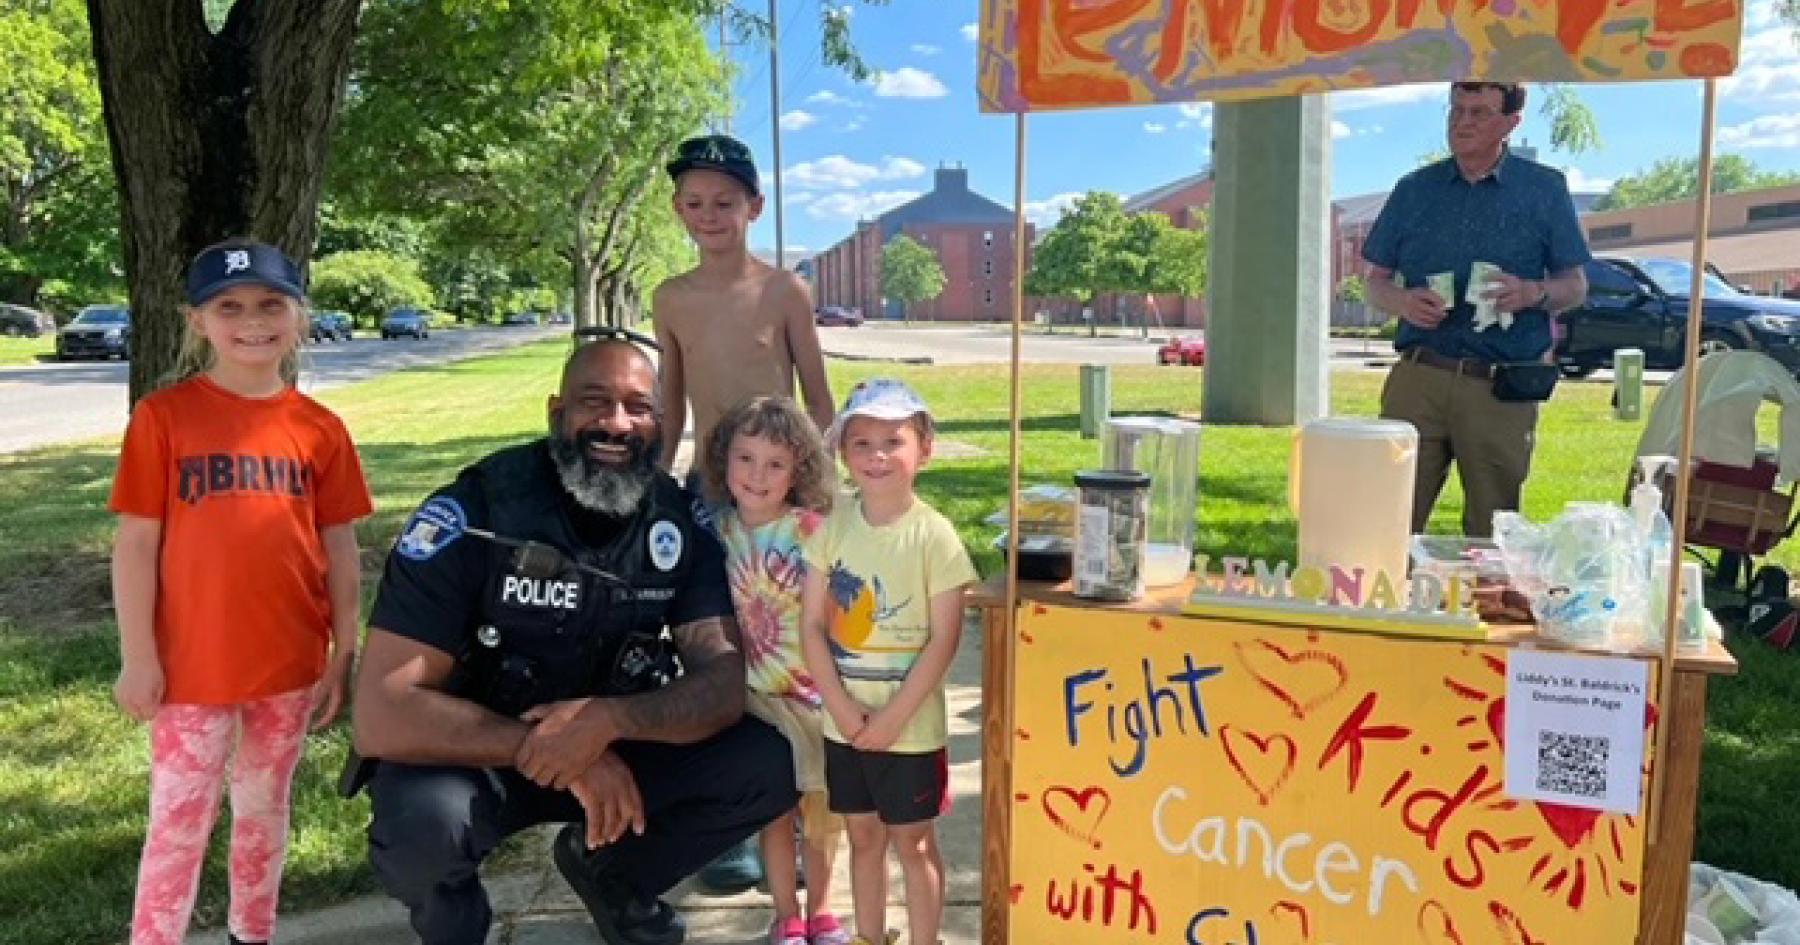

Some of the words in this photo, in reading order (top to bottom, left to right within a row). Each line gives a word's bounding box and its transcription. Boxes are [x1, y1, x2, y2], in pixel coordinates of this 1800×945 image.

[503, 576, 577, 608] POLICE
[1193, 553, 1479, 614] LEMONADE
[1064, 653, 1224, 777] Fight
[1532, 689, 1590, 704] Donation
[1592, 697, 1622, 711] Page
[1318, 691, 1501, 888] Kids
[1152, 785, 1419, 915] Cancer
[1047, 864, 1157, 935] with
